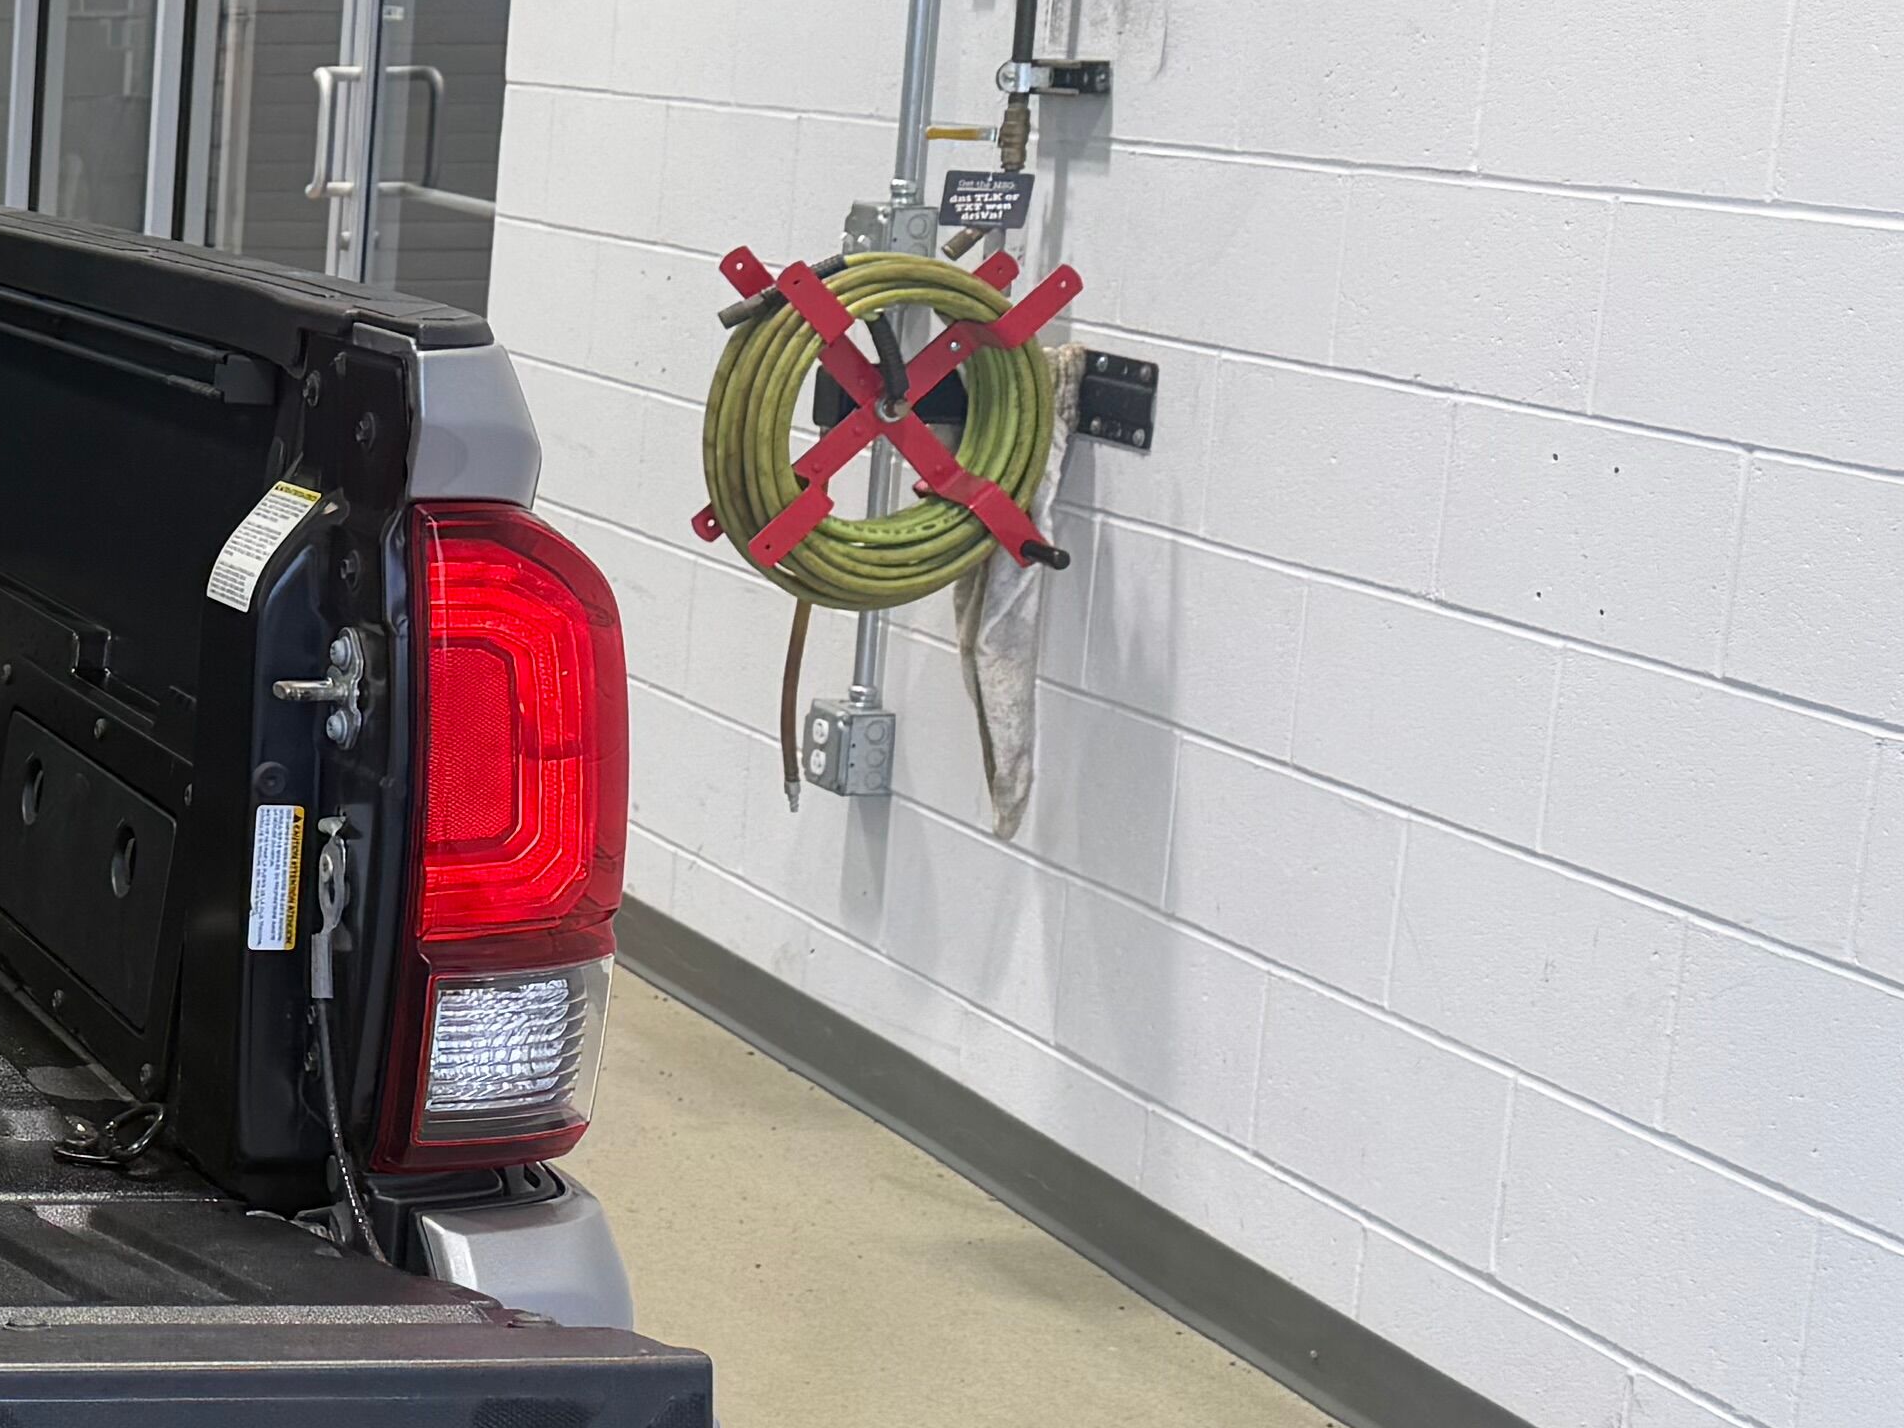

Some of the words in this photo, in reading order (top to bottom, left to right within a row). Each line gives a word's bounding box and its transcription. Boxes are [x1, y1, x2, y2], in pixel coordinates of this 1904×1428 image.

[958, 179, 974, 188] Get
[977, 179, 991, 188] the
[949, 194, 972, 203] dnt
[974, 192, 1004, 202] TLK
[1005, 193, 1020, 201] or
[954, 203, 983, 212] TXT
[985, 202, 1012, 210] wen
[291, 823, 301, 859] CAUTION
[288, 861, 299, 904] ATTENTION
